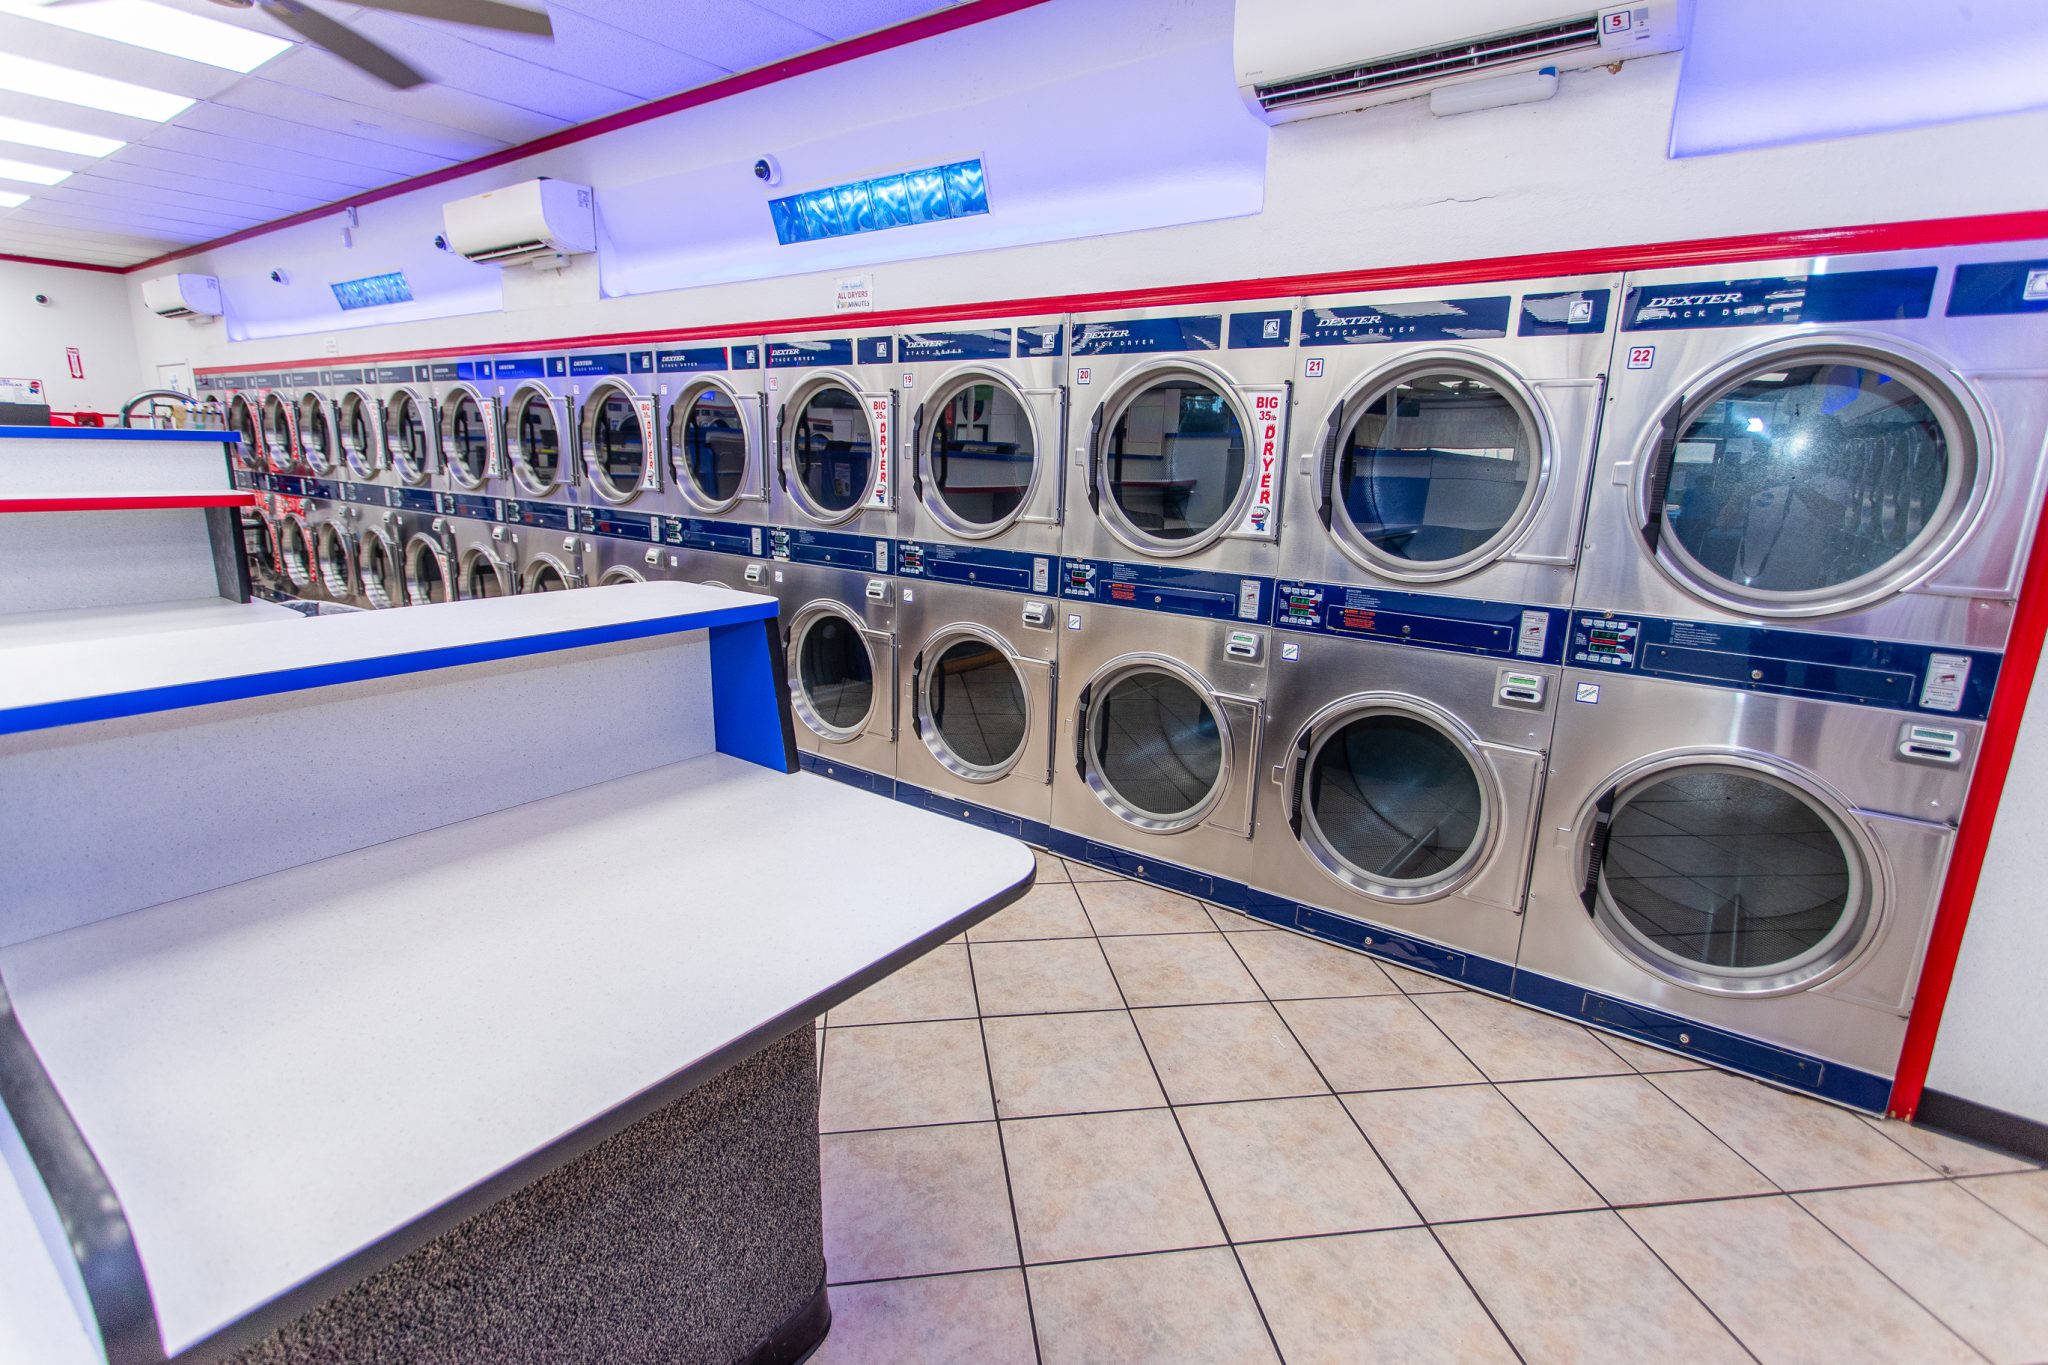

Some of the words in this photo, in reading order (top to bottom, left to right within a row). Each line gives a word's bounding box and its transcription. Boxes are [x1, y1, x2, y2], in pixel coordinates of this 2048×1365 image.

[1612, 15, 1621, 27] 5
[838, 292, 847, 300] ALL
[847, 290, 869, 299] DRYERS
[1646, 292, 1743, 308] DEXTER
[1722, 306, 1790, 317] DRYER
[1316, 315, 1382, 327] DEXTER
[1083, 329, 1130, 339] DEXTER
[1315, 329, 1357, 337] STACK
[1368, 326, 1415, 334] DRYER
[906, 340, 944, 349] DEXTER
[1120, 338, 1154, 346] DRYER
[771, 348, 800, 356] DEXTER
[1632, 349, 1650, 362] 22
[1308, 360, 1321, 371] 21
[905, 375, 912, 384] 19
[1080, 370, 1089, 379] 20
[873, 401, 887, 410] BIG
[1256, 397, 1279, 408] BIG
[1258, 411, 1277, 421] 35lb
[1259, 424, 1276, 505] DRYER
